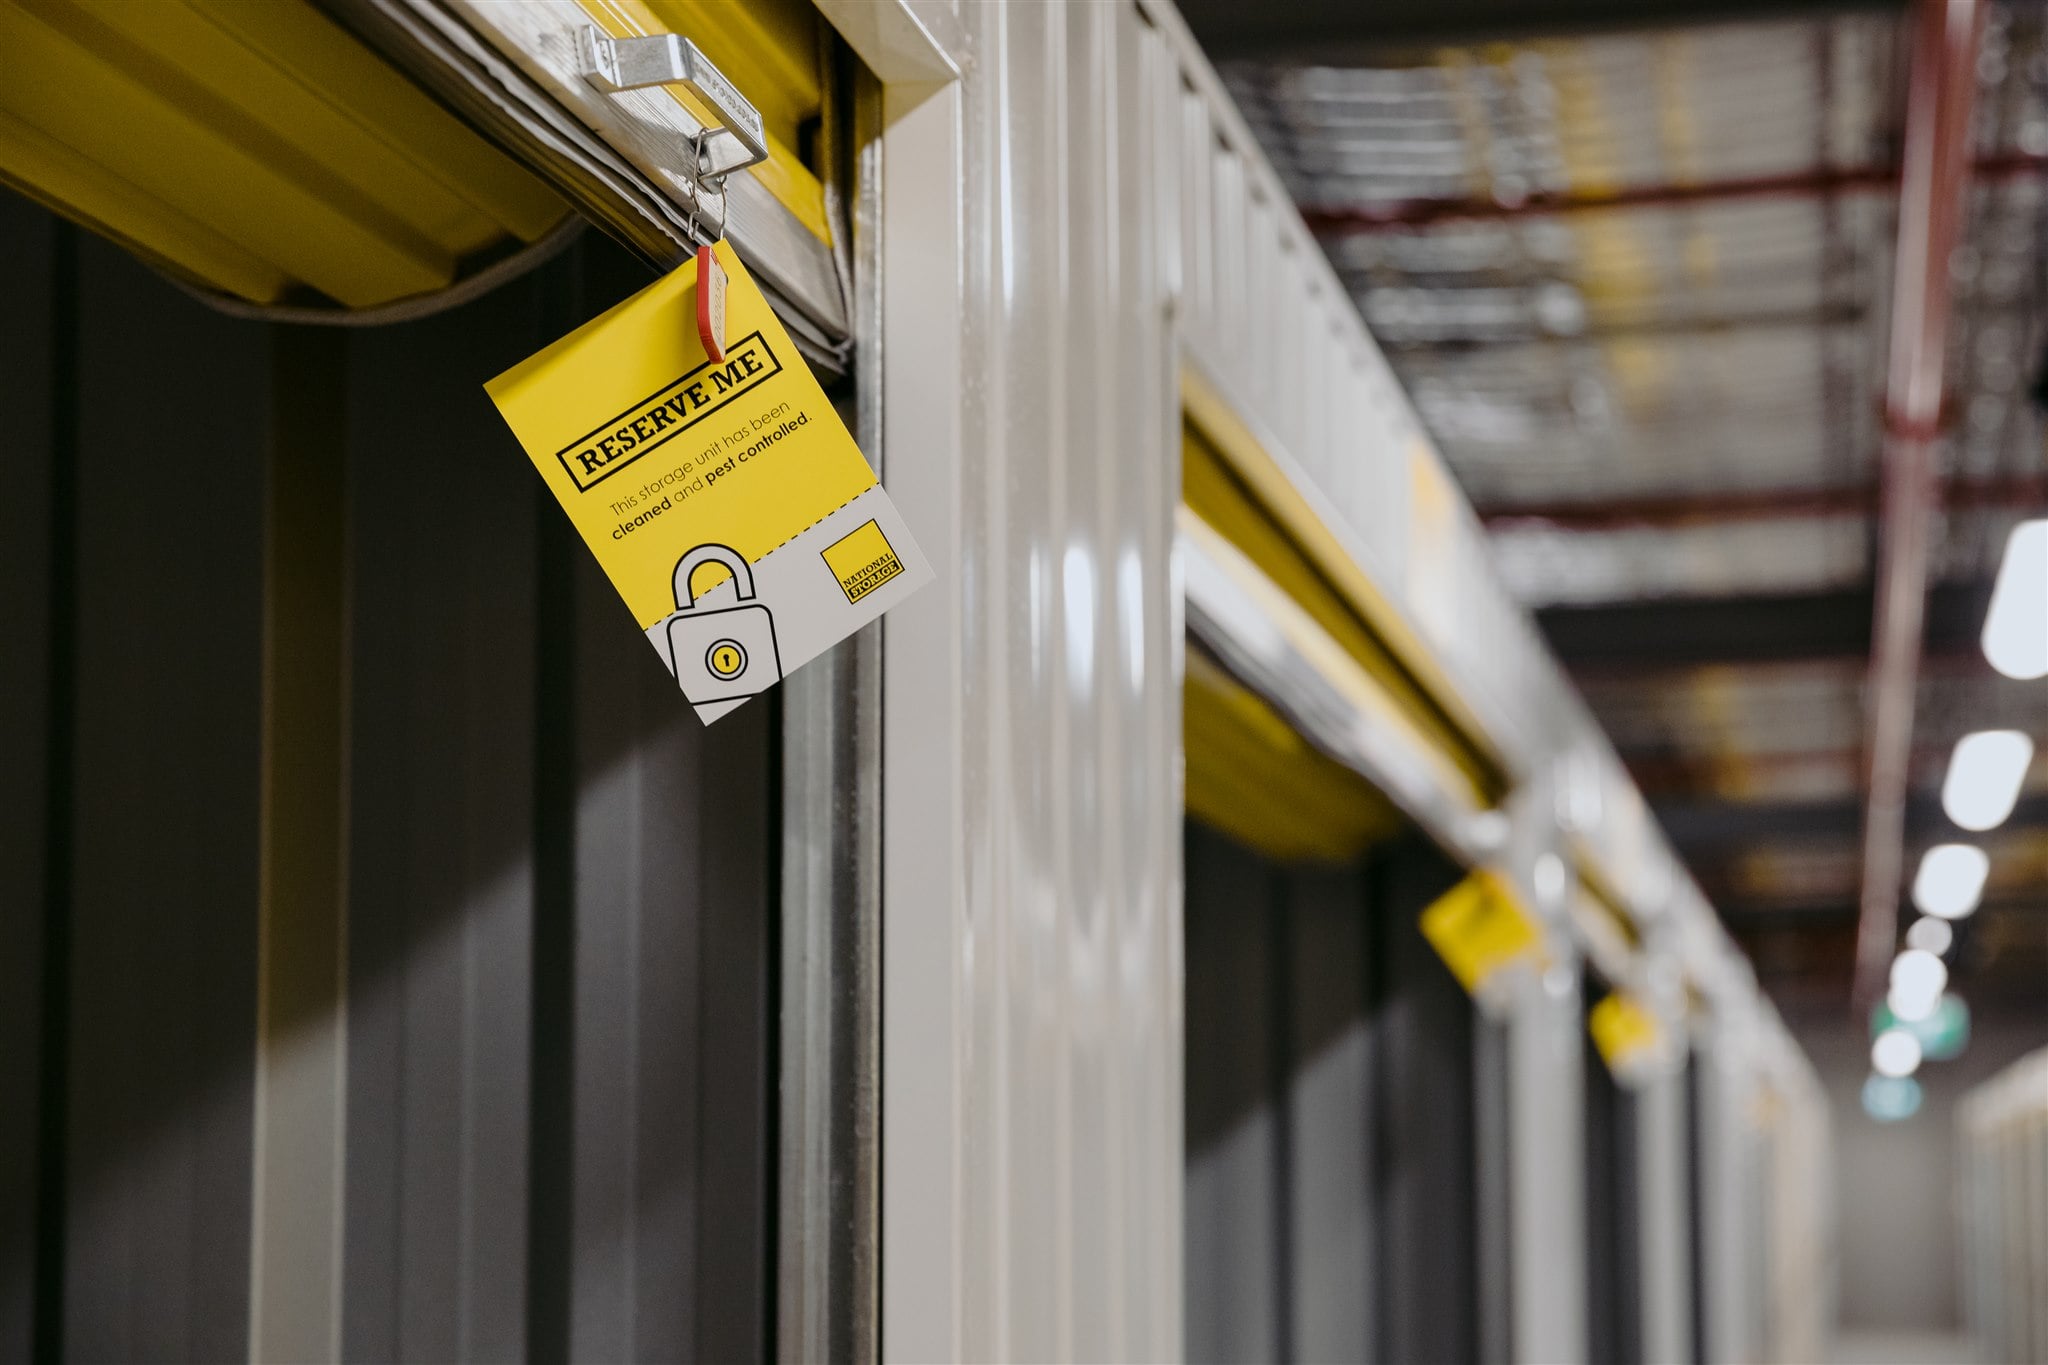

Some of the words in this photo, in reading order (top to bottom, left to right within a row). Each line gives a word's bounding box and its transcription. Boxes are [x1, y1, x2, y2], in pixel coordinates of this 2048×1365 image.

[576, 381, 711, 475] RESERVE
[708, 349, 764, 394] ME
[609, 496, 638, 516] This
[638, 462, 693, 501] storage
[695, 441, 722, 466] unit
[722, 427, 750, 448] has
[749, 402, 790, 431] been
[612, 496, 672, 540] cleaned
[674, 477, 704, 502] and
[705, 457, 736, 486] pest
[738, 411, 813, 462] controlled.
[843, 553, 893, 587] NATIONAL
[850, 562, 897, 597] STORAGE
